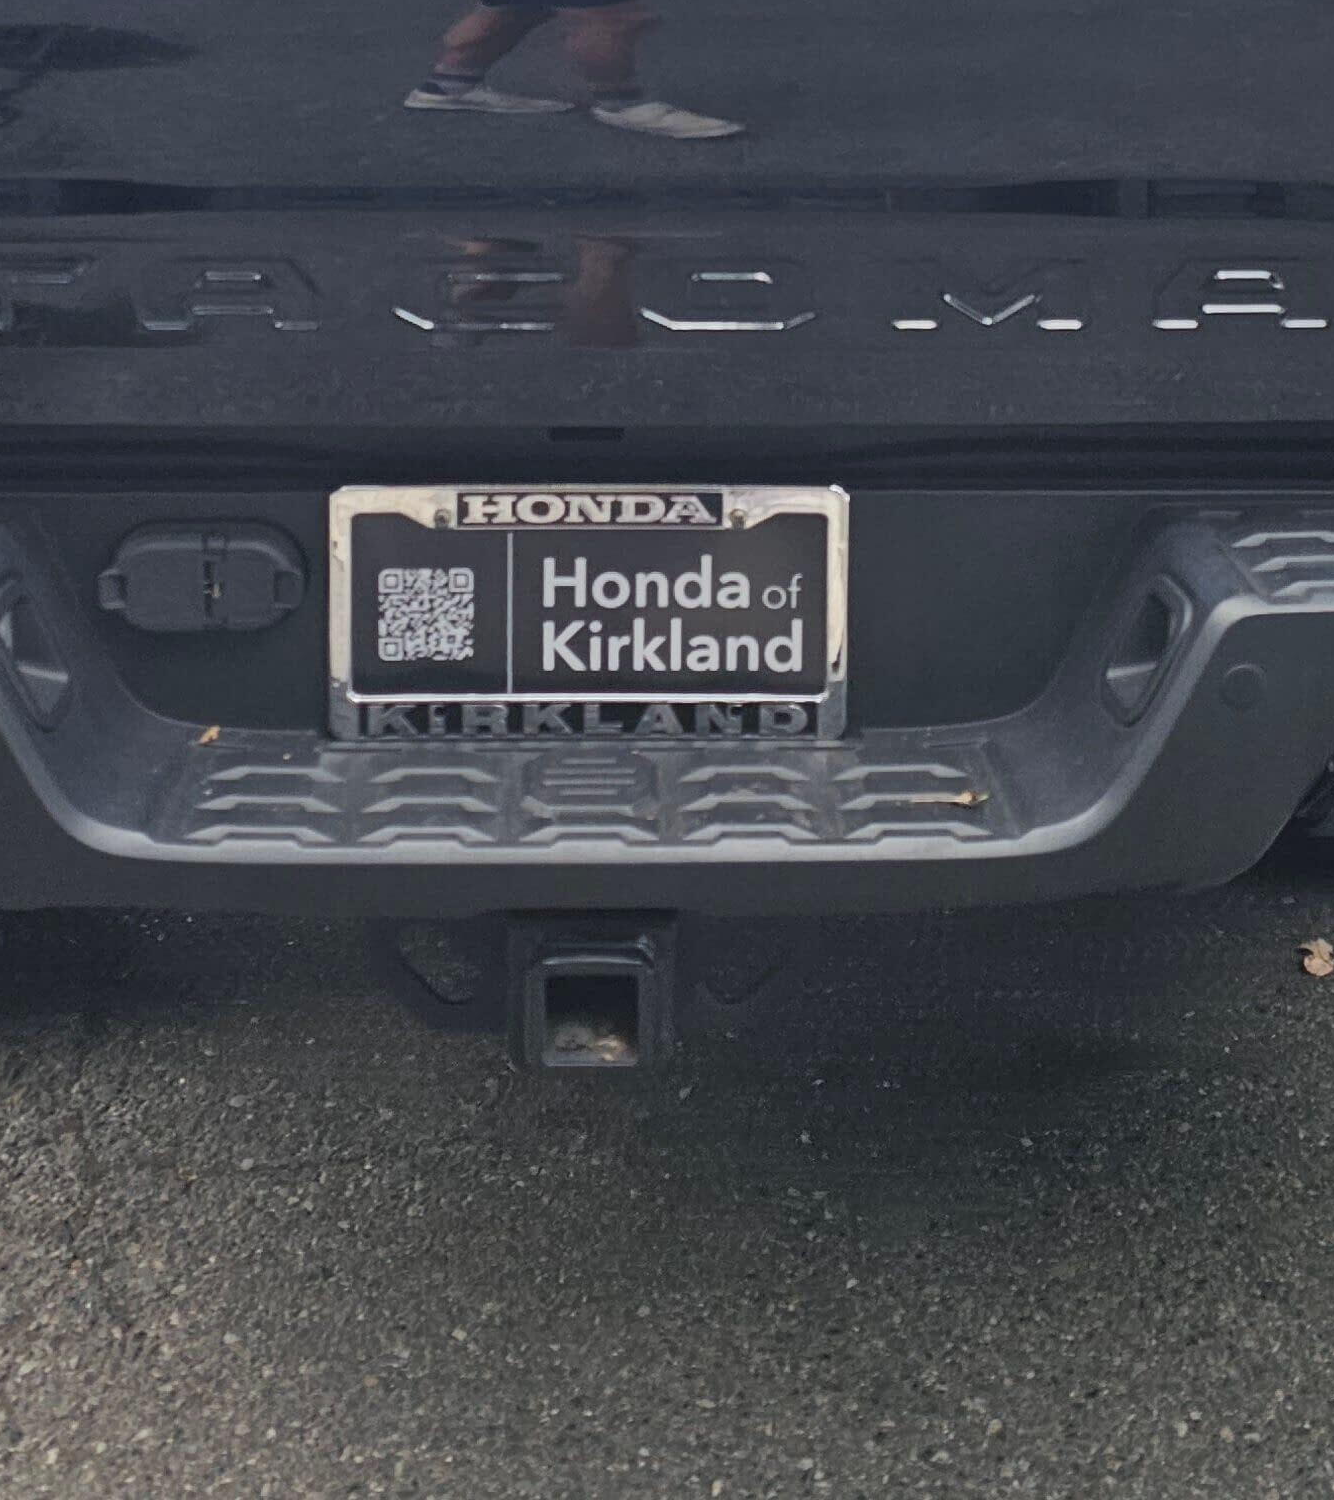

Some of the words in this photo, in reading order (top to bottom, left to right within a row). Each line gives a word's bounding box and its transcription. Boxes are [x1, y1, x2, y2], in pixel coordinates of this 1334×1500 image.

[463, 495, 717, 524] HONDA
[542, 555, 750, 609] Honda
[762, 573, 804, 610] of
[542, 618, 803, 672] Kirkland
[371, 704, 810, 736] KIRKLAND
